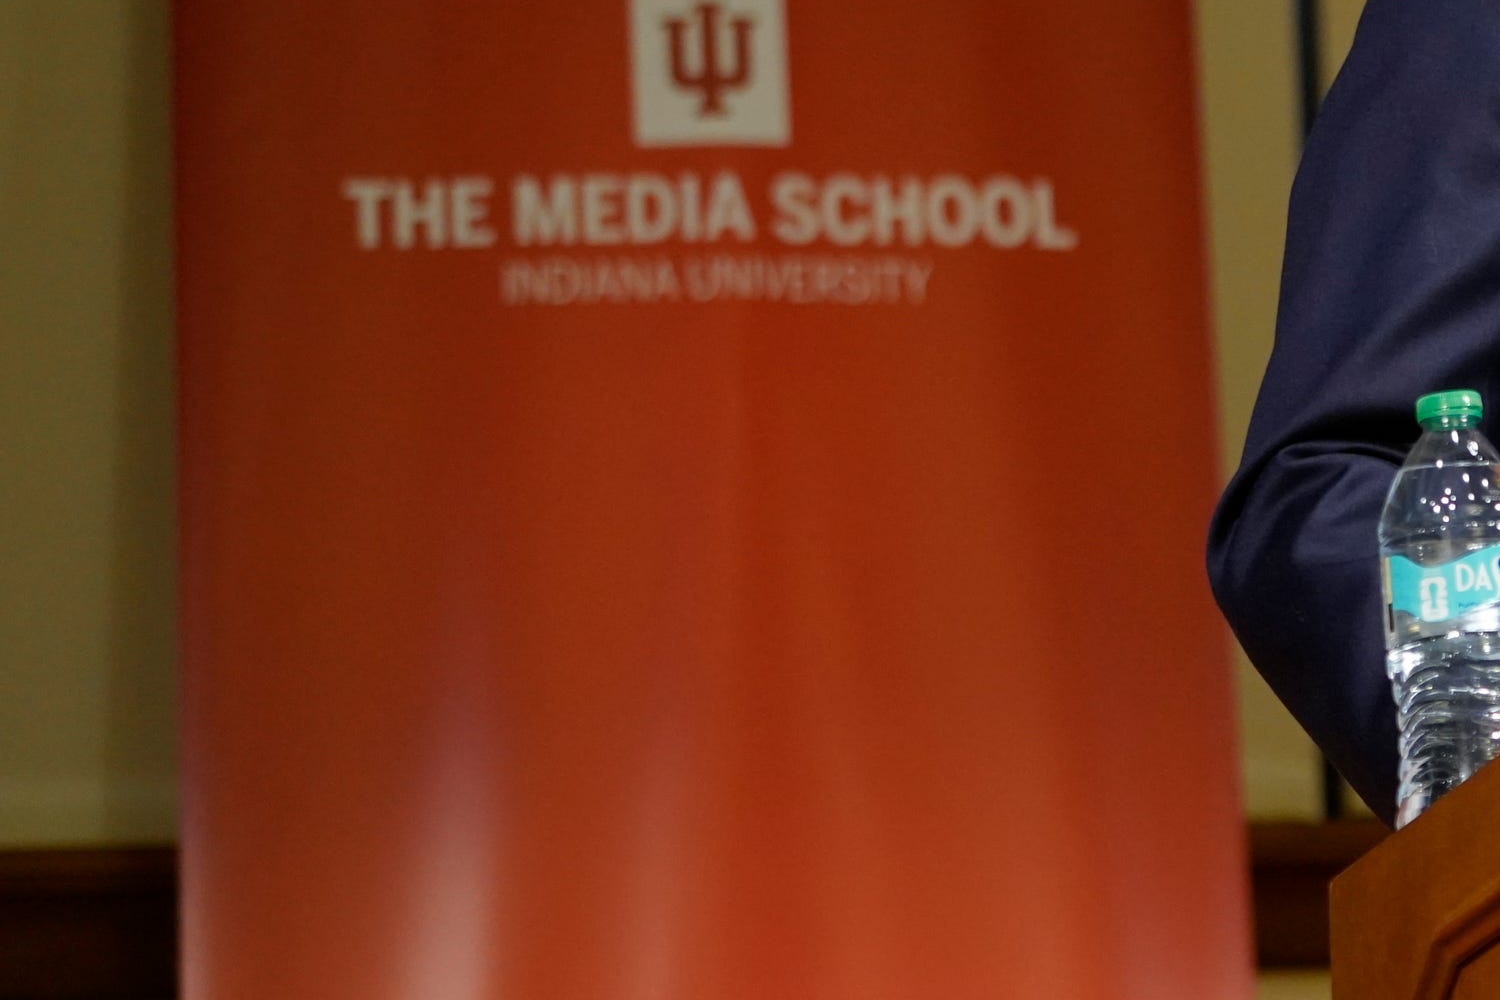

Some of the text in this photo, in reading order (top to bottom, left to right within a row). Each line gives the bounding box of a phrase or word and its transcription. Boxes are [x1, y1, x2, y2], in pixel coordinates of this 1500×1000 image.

[344, 172, 1077, 250] THE MEDIA SCHOOL
[502, 256, 932, 304] INDIANA UNIVERSITY
